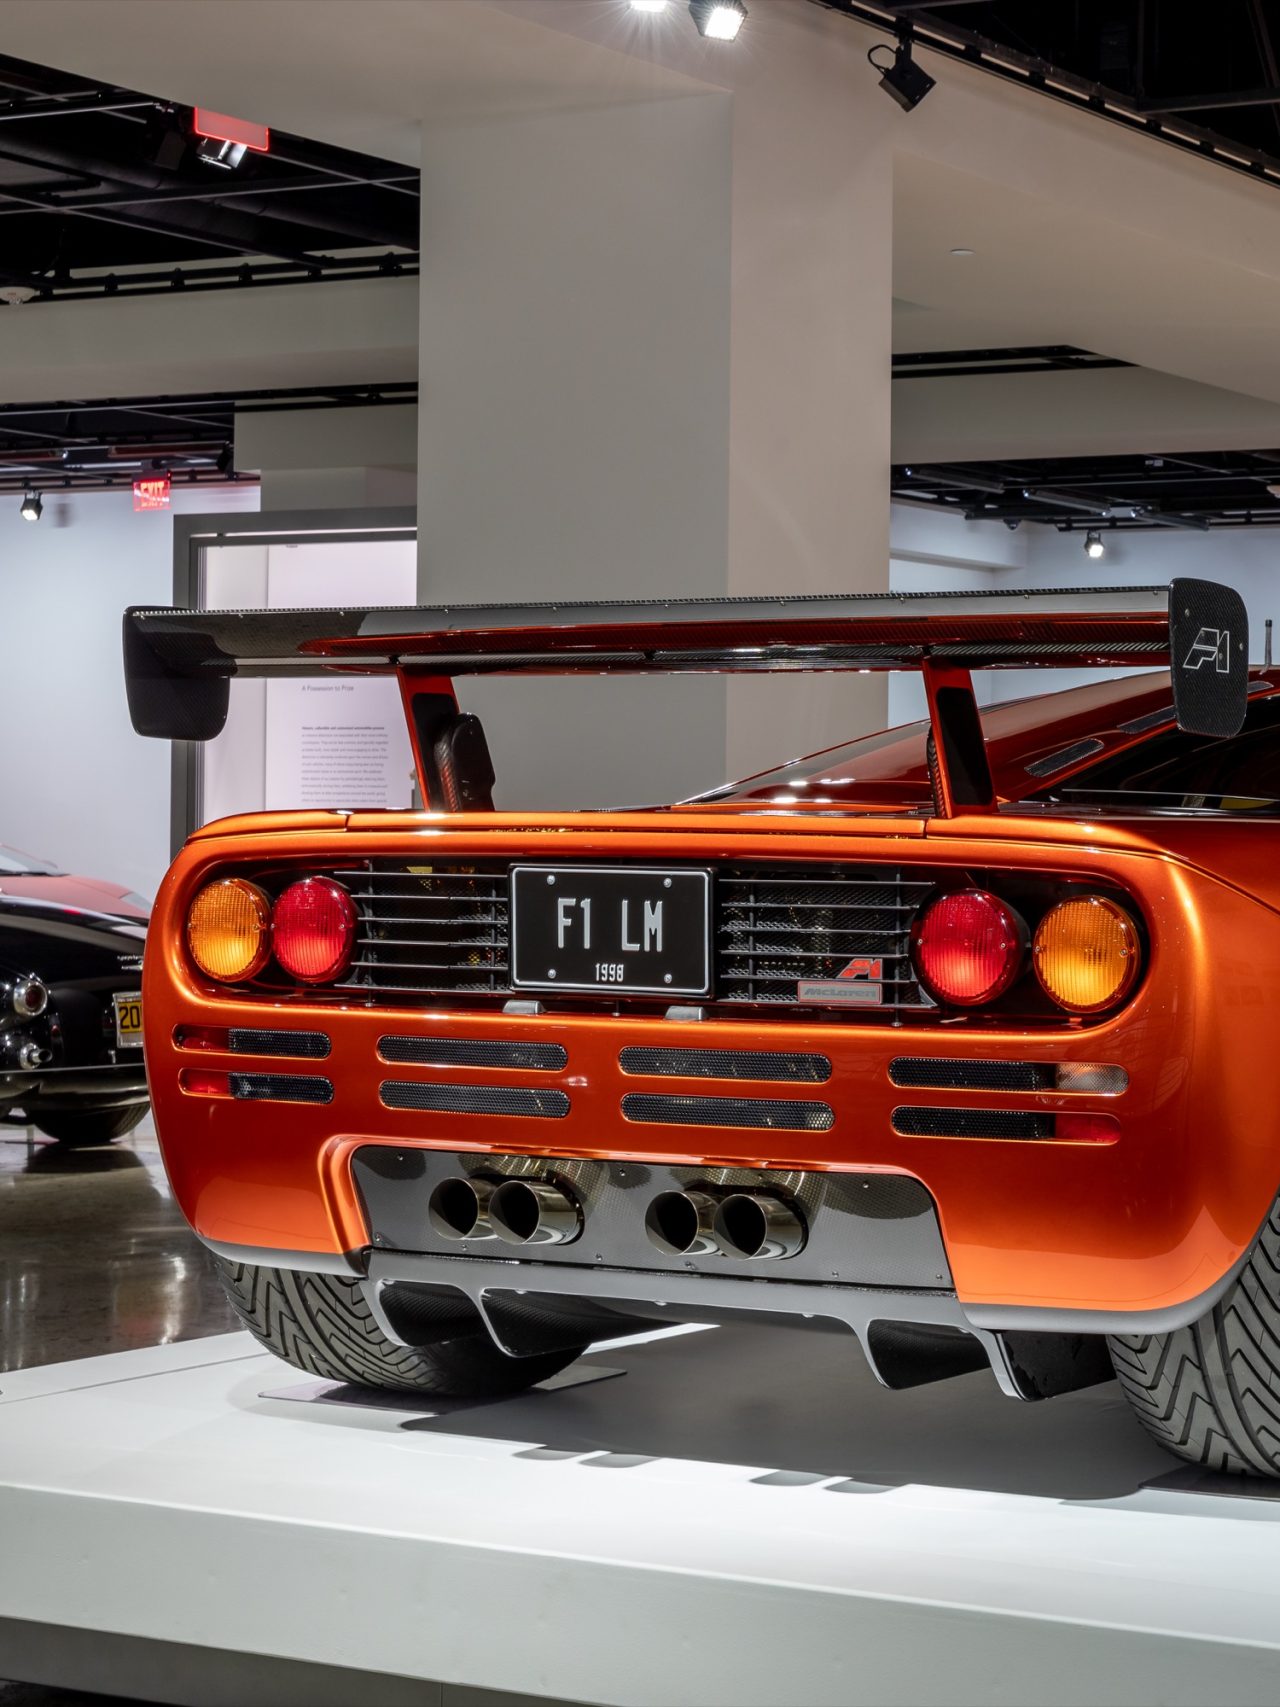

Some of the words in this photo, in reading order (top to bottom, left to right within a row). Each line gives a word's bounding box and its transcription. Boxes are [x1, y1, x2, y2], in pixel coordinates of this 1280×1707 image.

[140, 481, 165, 497] EXIT
[557, 898, 591, 949] F1
[621, 899, 663, 952] LM
[595, 962, 624, 982] 1998
[803, 988, 877, 998] McLaren
[119, 1005, 143, 1029] 20
